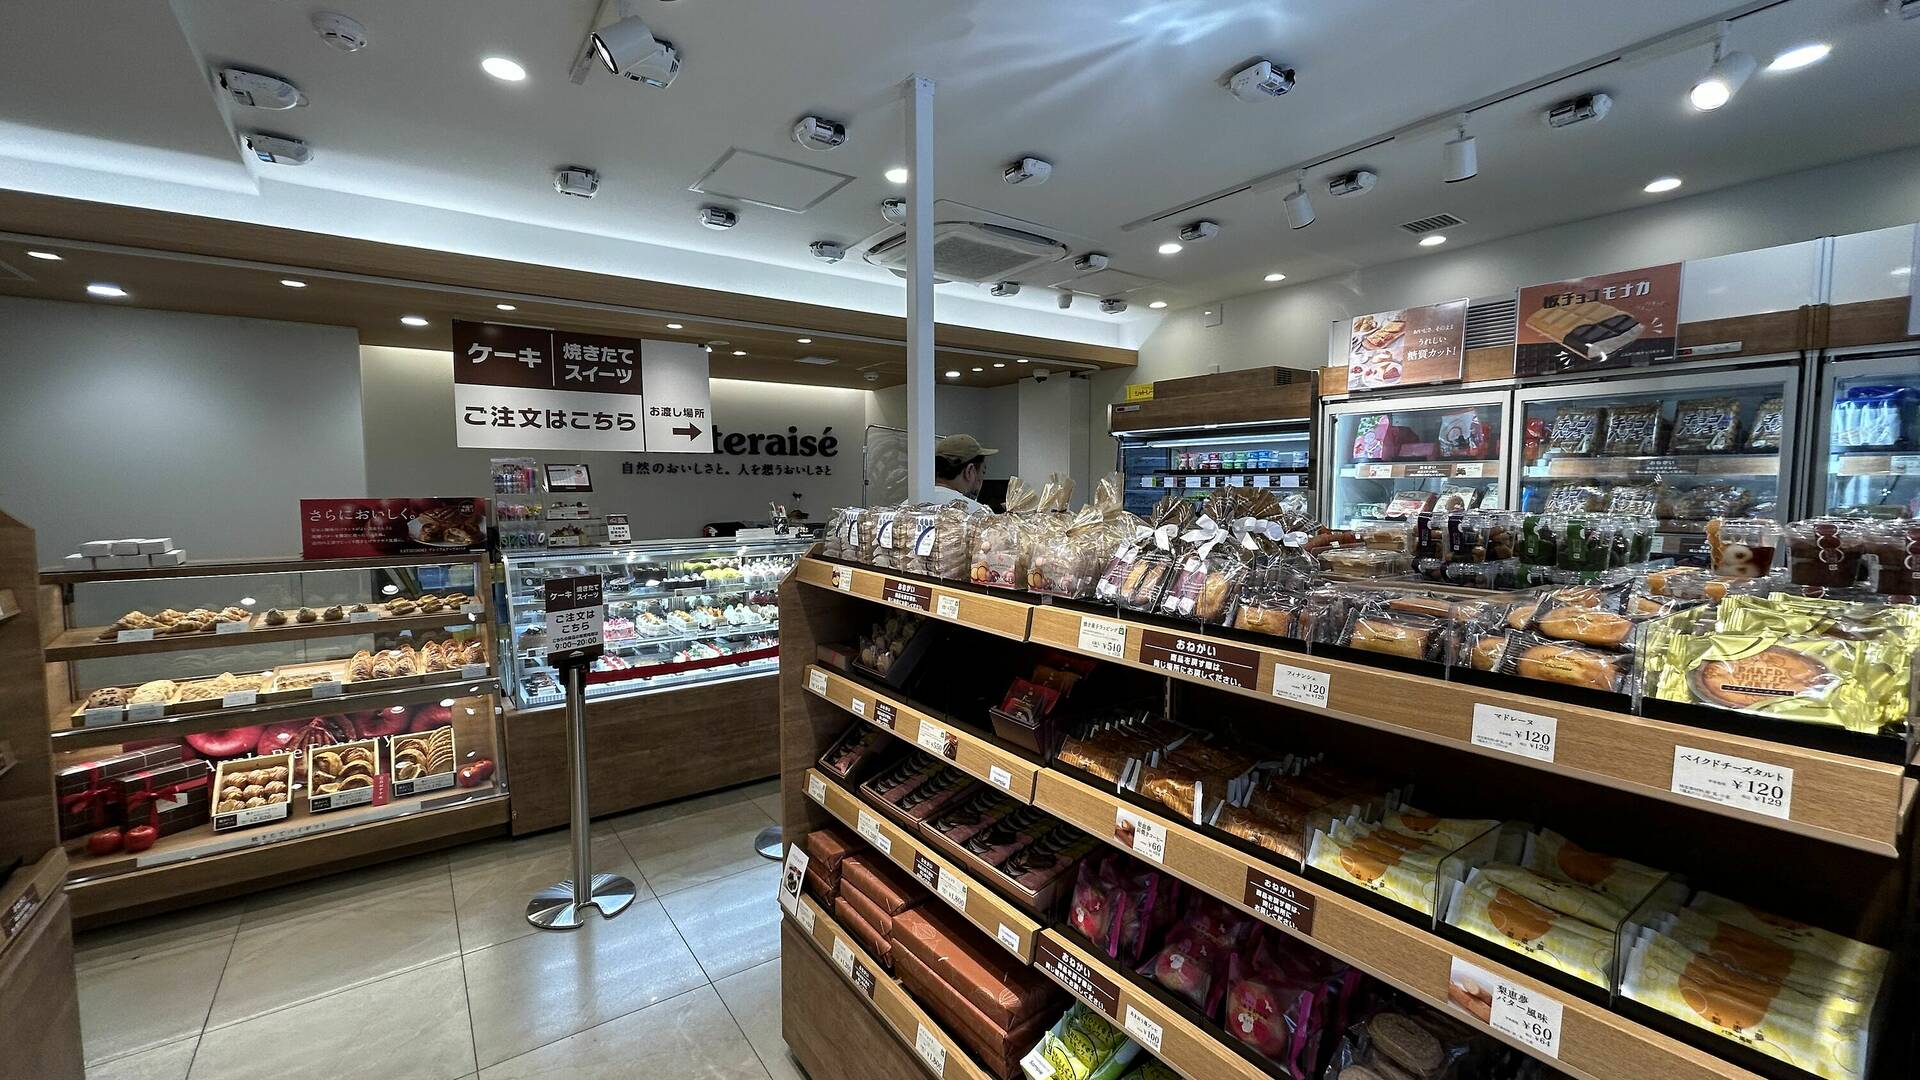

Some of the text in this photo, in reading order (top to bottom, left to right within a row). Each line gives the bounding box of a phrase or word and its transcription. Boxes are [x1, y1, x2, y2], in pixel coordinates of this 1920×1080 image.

[1418, 336, 1447, 346] うれしい
[468, 342, 542, 368] ケーキ
[562, 342, 634, 364] 焼きたて
[564, 364, 633, 384] スイーツ
[464, 405, 636, 432] ご注文はこちら
[649, 406, 705, 419] お渡し場所
[309, 506, 416, 522] さらにおいしく。
[550, 591, 572, 600] ケーキ
[576, 592, 600, 600] スイーツ
[556, 610, 595, 623] ご注文は
[562, 621, 590, 633] こちら
[1176, 639, 1216, 656] おねがい
[1170, 653, 1224, 673] 商品を戻す際は、
[1153, 659, 1242, 687] 同じ場所にお戻しください。
[1302, 684, 1326, 695] ¥120
[1494, 713, 1534, 726] マドレーヌ
[1515, 730, 1551, 746] ¥120
[1530, 743, 1550, 752] ¥129
[1680, 754, 1784, 782] ベイクドチーズタルト
[1733, 779, 1784, 800] ¥120
[1754, 796, 1782, 807] ¥129
[1148, 842, 1162, 853] ¥60
[1264, 879, 1295, 899] おねがい
[1061, 952, 1091, 978] おねがい
[1496, 984, 1529, 1004] 梨恵夢
[1496, 995, 1550, 1024] バター風味
[1143, 1029, 1160, 1044] ¥100
[1522, 1020, 1552, 1041] ¥60
[1534, 1036, 1551, 1047] ¥64
